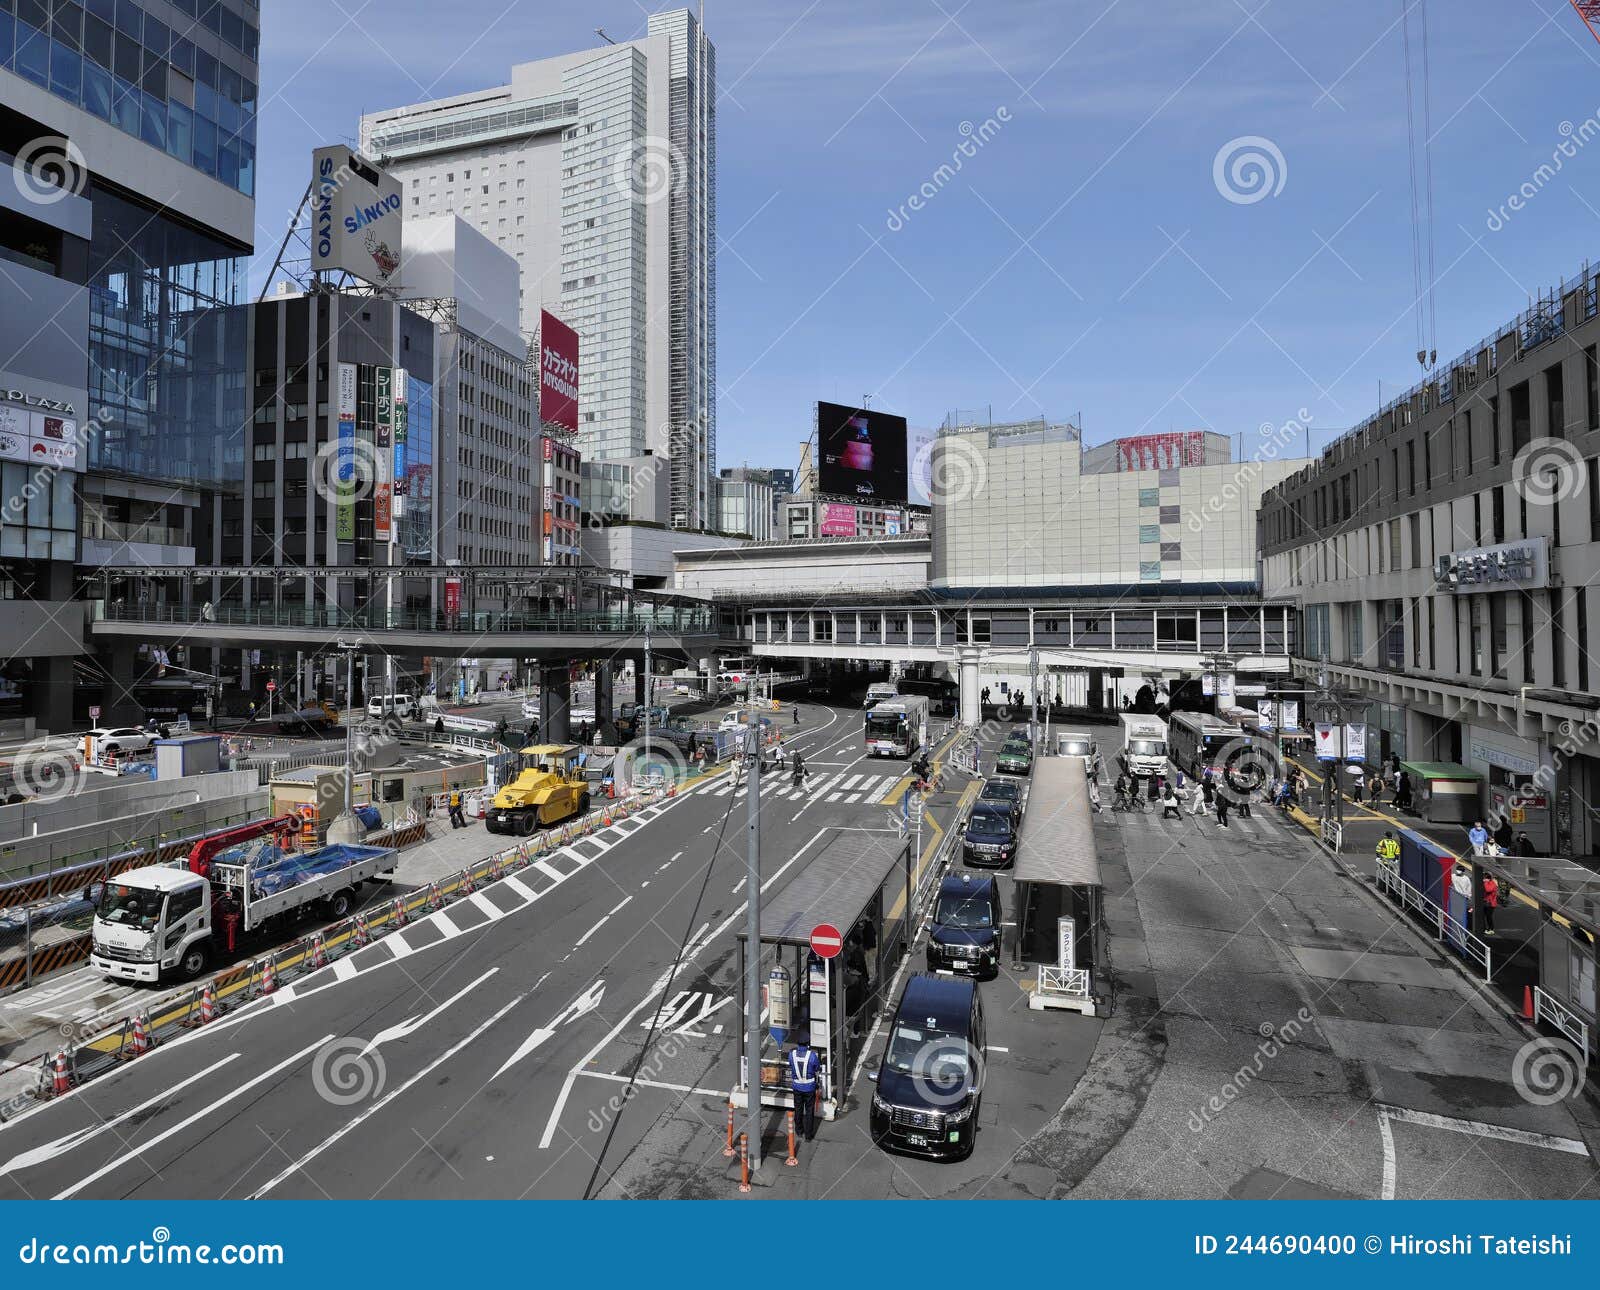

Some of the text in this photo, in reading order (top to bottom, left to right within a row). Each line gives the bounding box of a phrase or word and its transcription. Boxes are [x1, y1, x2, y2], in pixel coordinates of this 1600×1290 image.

[344, 193, 401, 234] SANKYO
[543, 345, 578, 383] カラオケ
[8, 390, 75, 415] PLAZA
[543, 370, 578, 401] JOYSOUND
